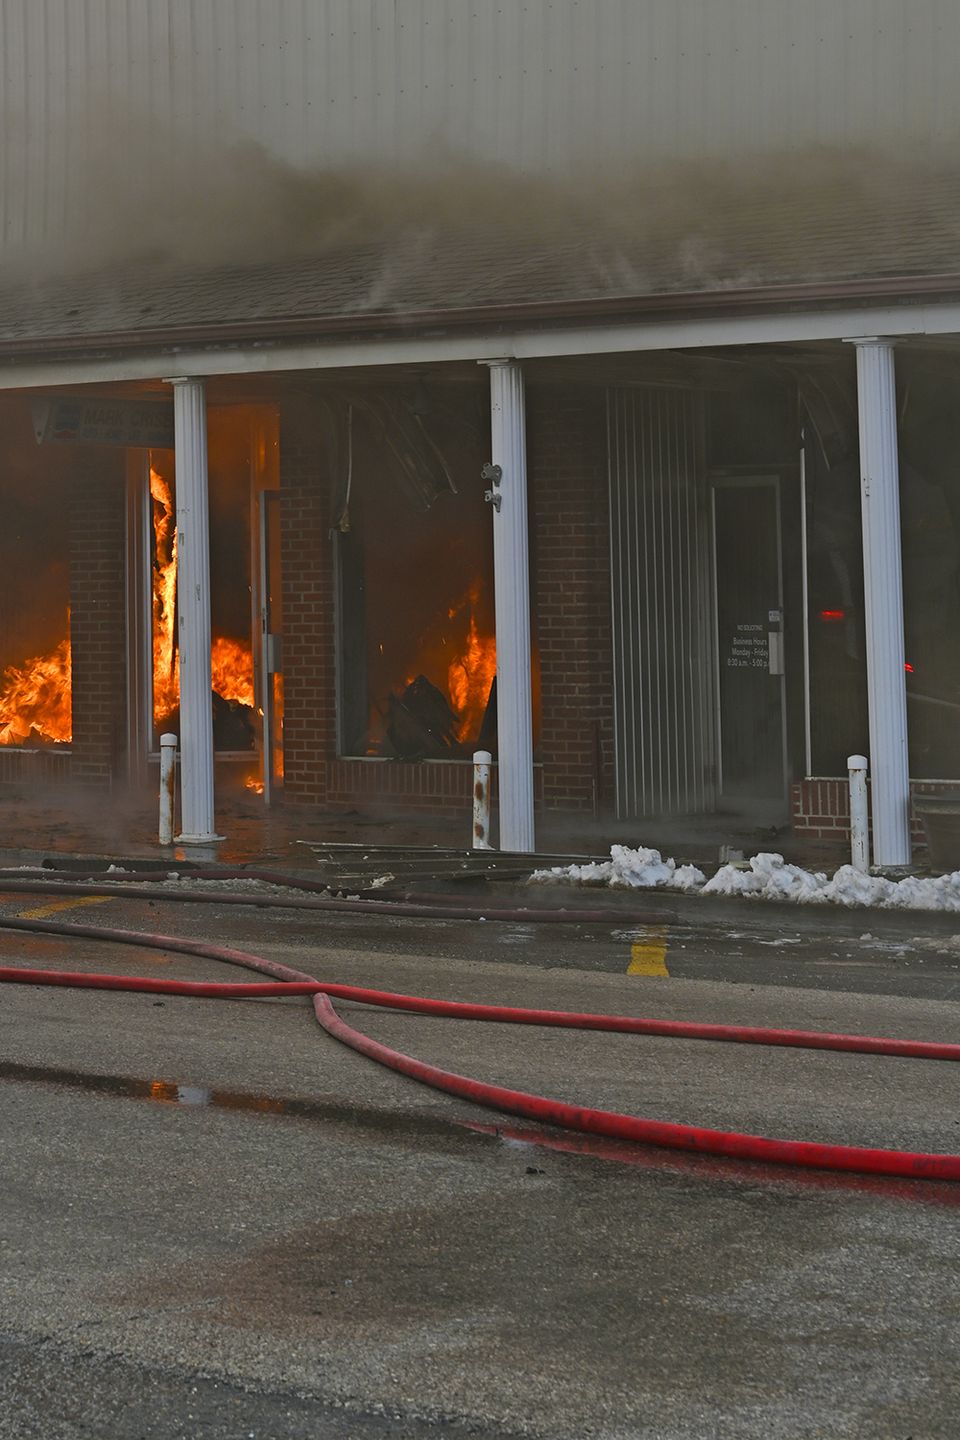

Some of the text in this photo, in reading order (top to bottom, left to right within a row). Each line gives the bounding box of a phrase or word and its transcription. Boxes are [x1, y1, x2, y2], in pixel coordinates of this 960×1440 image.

[733, 637, 767, 645] Business Hours
[731, 647, 750, 658] Monday
